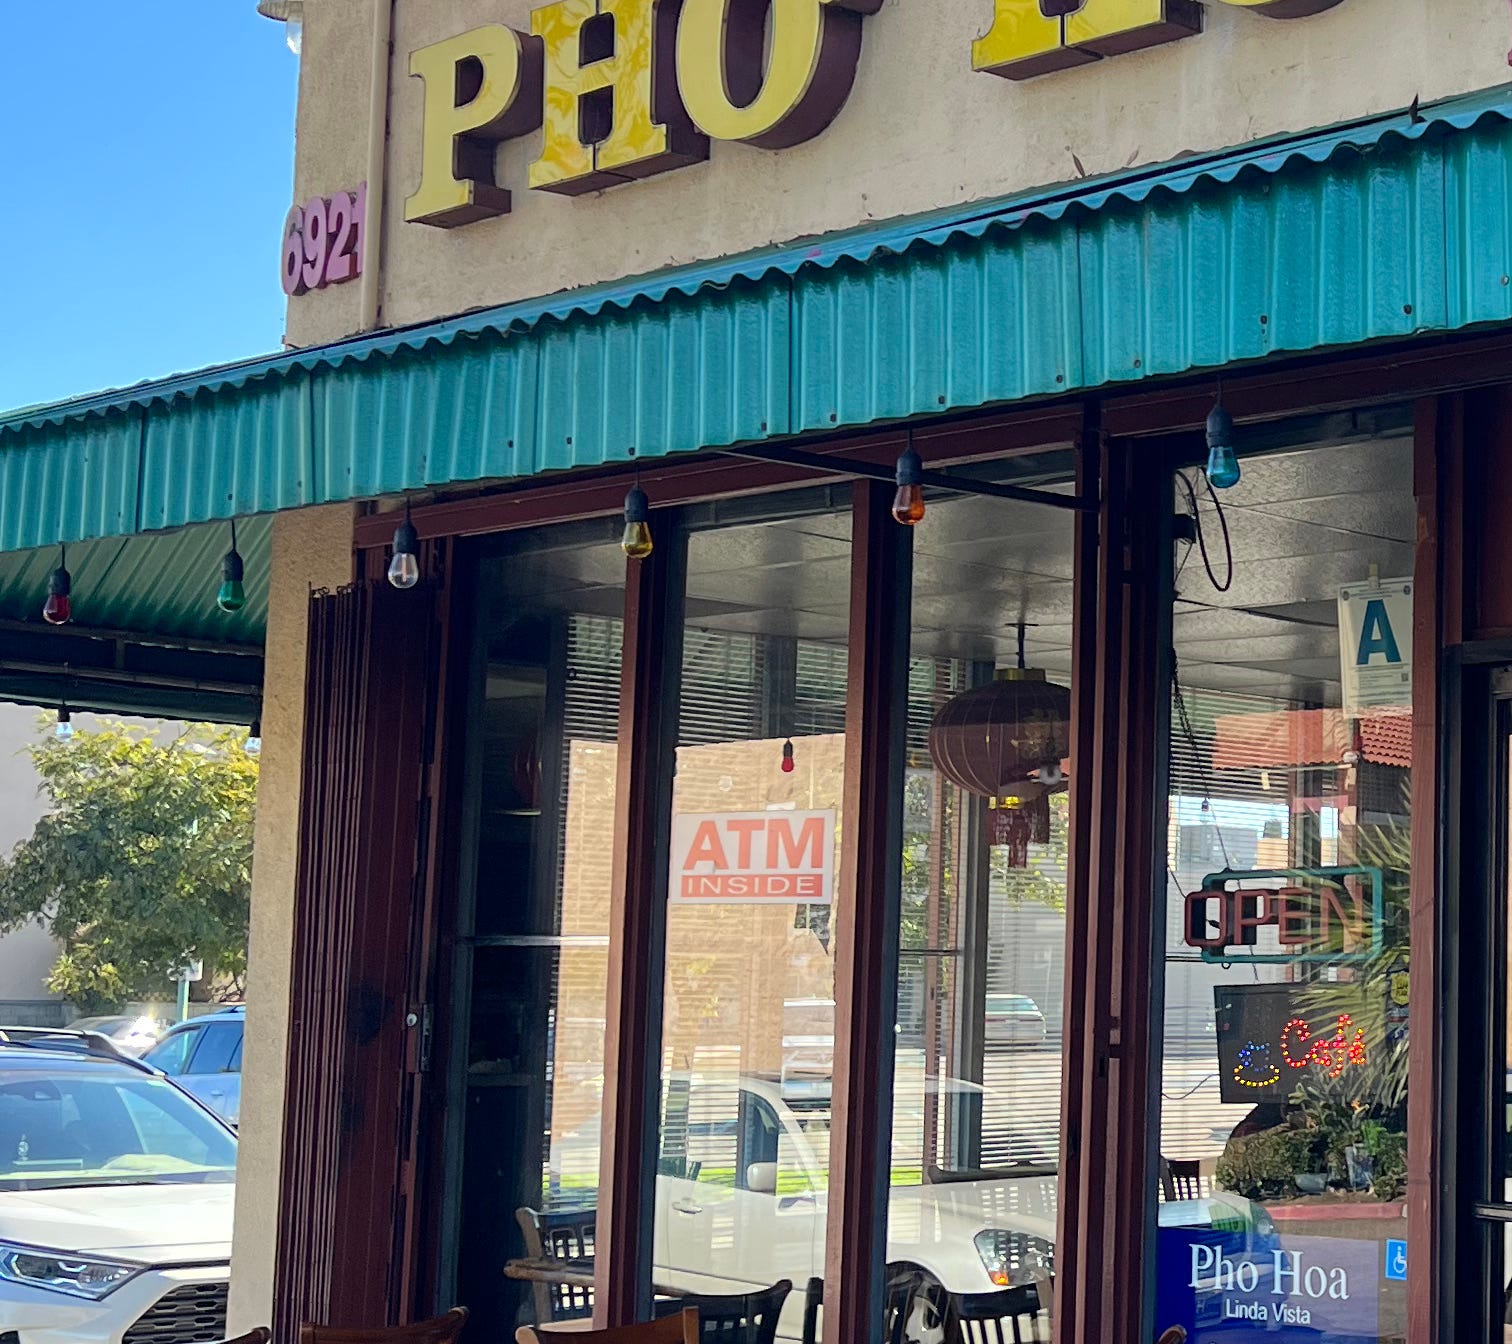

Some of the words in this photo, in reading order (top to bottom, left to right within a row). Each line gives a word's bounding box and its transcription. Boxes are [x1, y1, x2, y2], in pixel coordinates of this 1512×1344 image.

[1356, 599, 1402, 666] A
[682, 817, 826, 870] ATM
[686, 876, 816, 895] INSIDE
[1184, 887, 1364, 948] OPEN
[1188, 1243, 1259, 1293] Pho
[1271, 1249, 1349, 1300] Hoa
[1226, 1298, 1267, 1321] Linda
[1272, 1302, 1311, 1324] Vista
